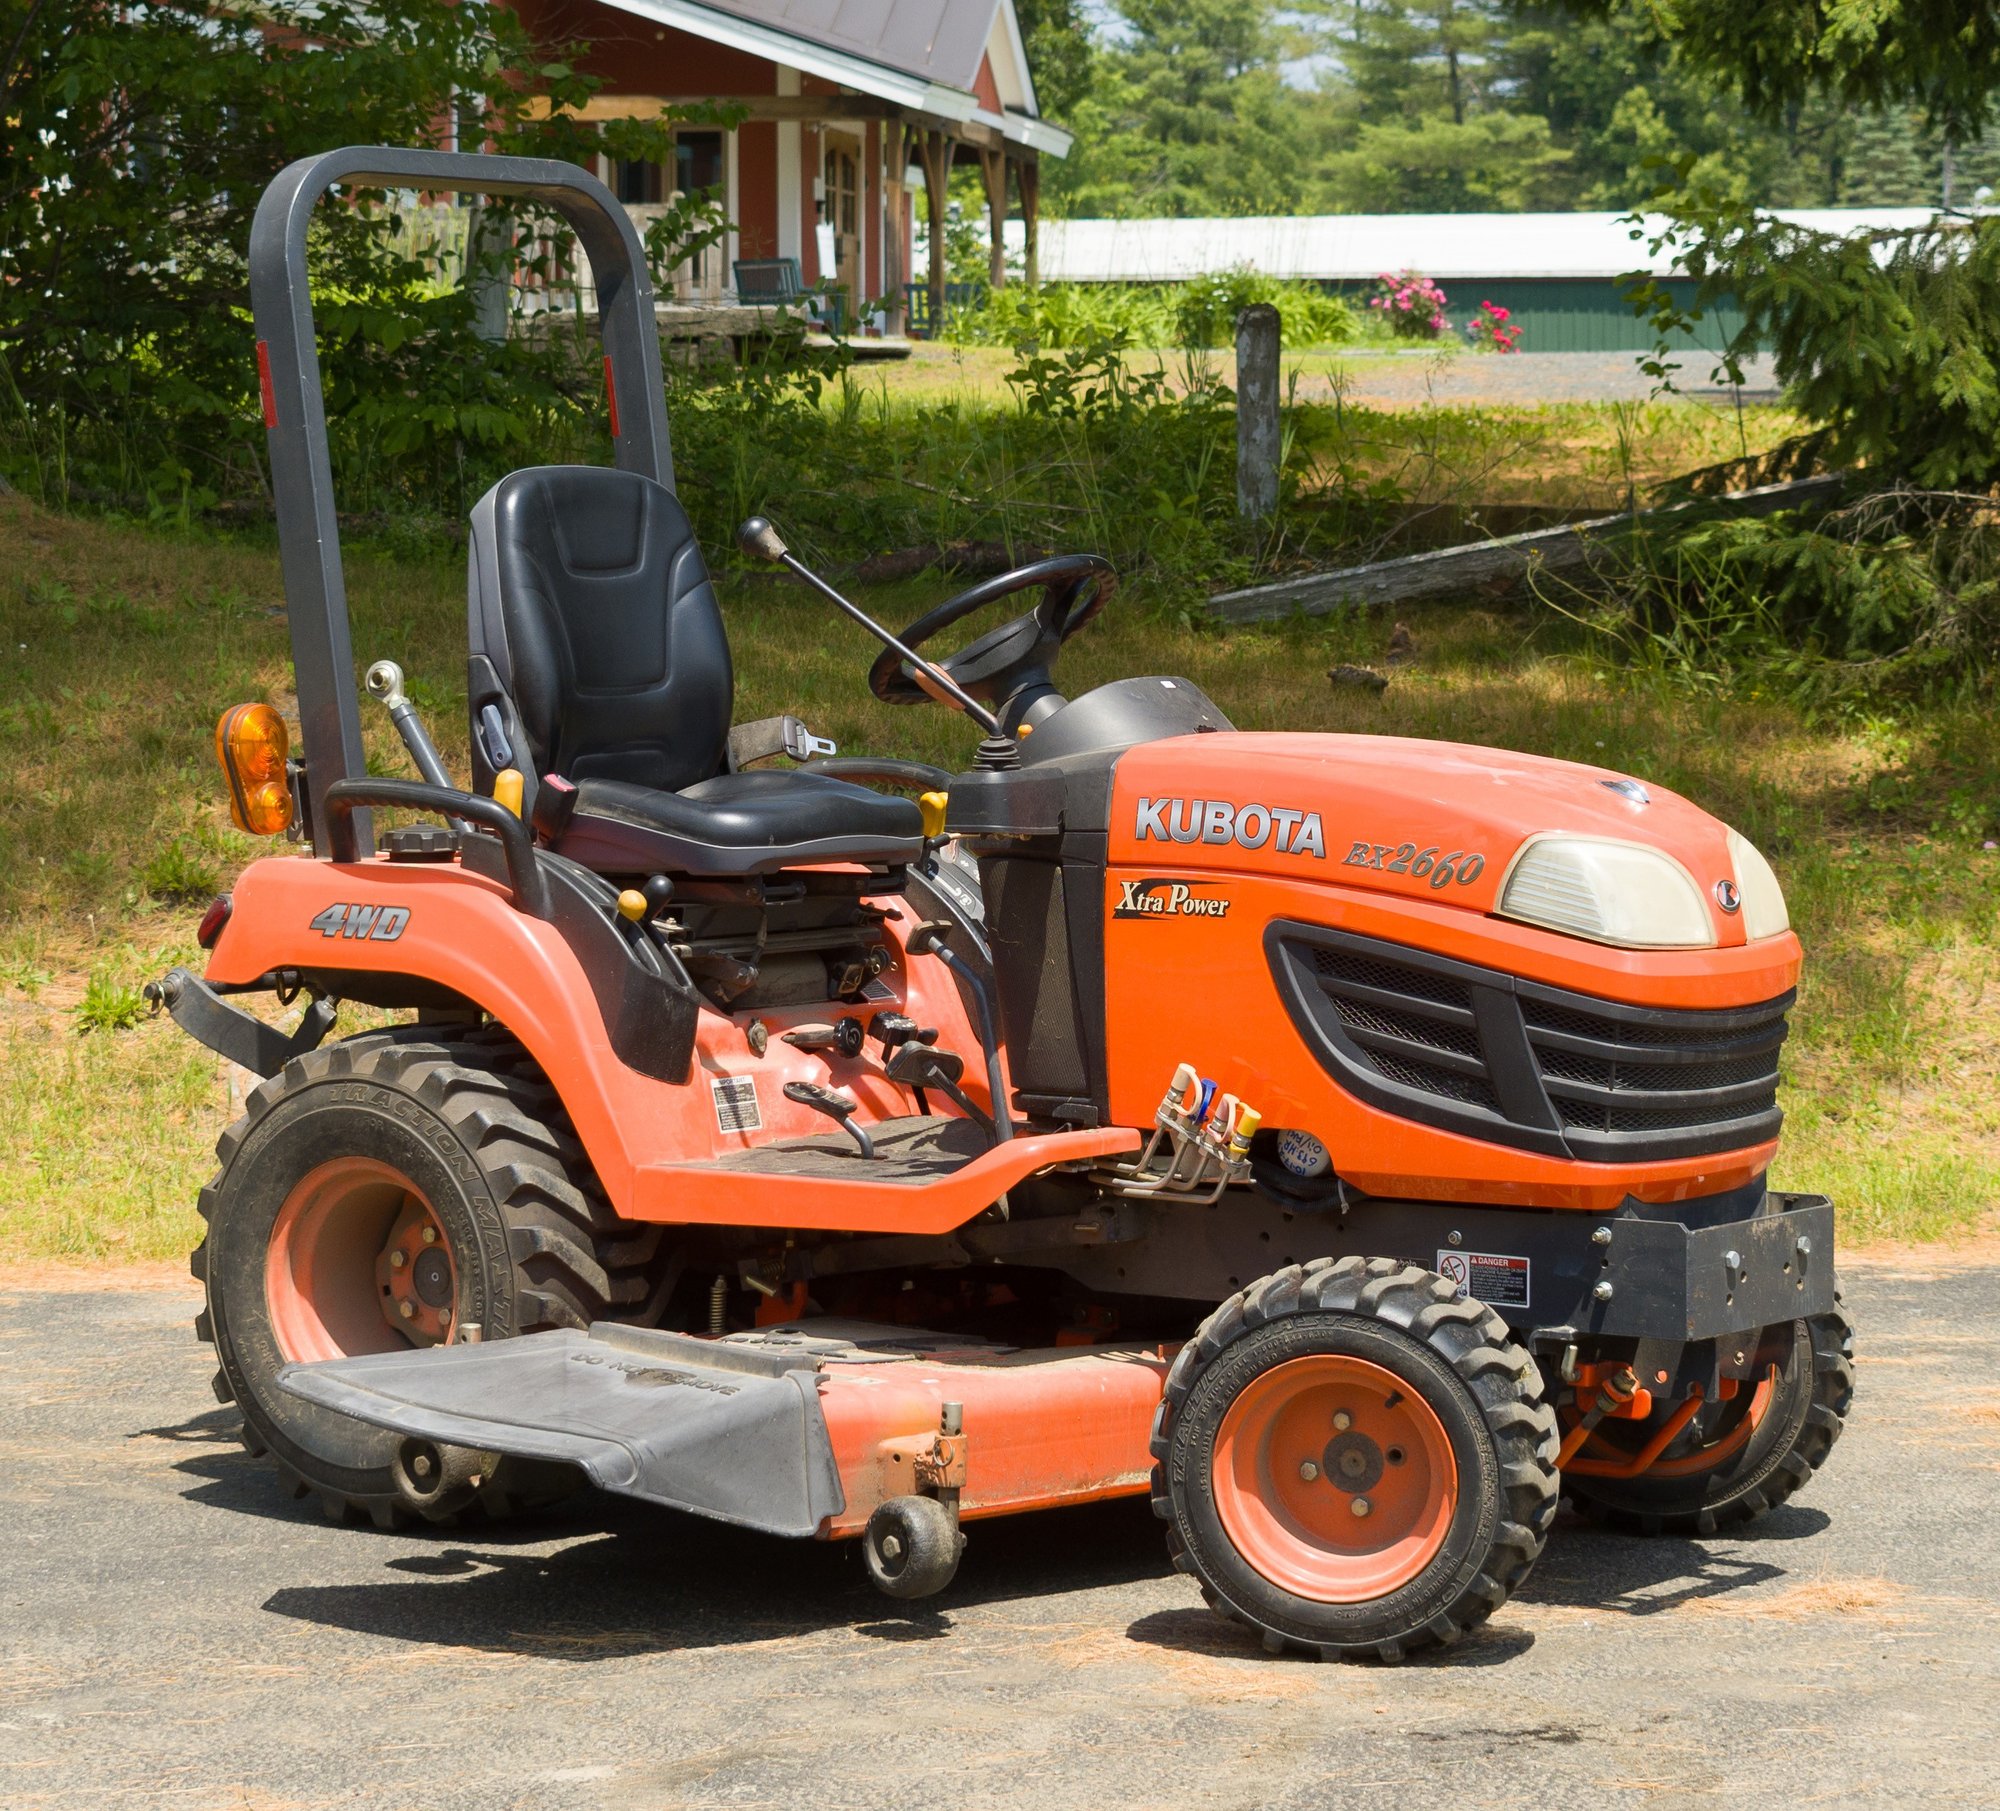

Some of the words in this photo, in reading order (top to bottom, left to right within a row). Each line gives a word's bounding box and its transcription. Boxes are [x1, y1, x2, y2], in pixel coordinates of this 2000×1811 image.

[1135, 797, 1326, 859] KUBOTA
[1342, 841, 1486, 889] BX2660
[1114, 881, 1163, 913] Xtra
[1166, 884, 1229, 917] Power
[309, 902, 411, 942] 4WD
[329, 1083, 481, 1183] TRACTION
[1478, 1258, 1509, 1266] DANGER
